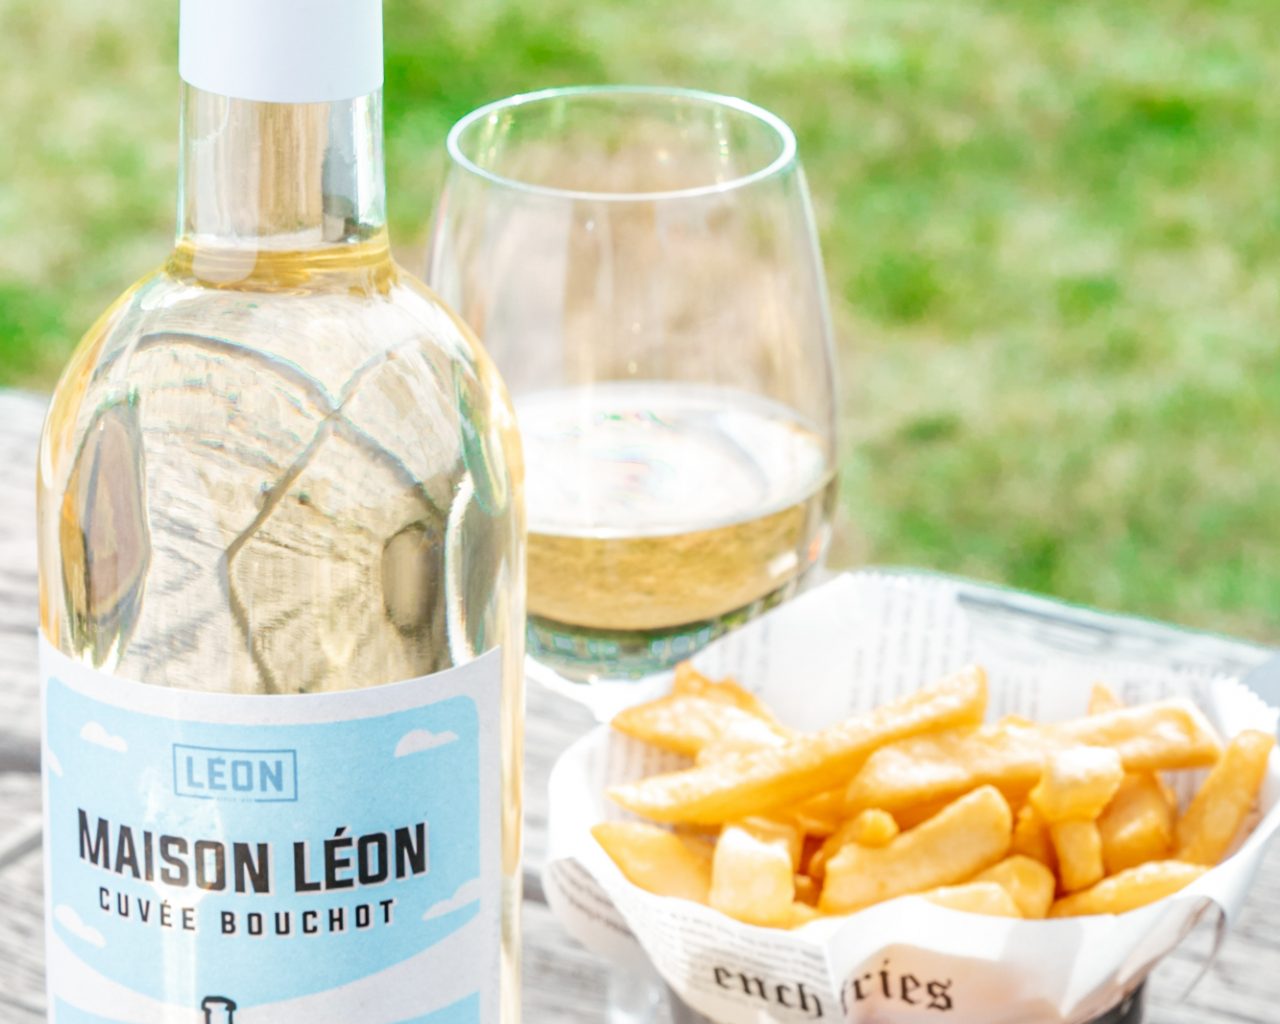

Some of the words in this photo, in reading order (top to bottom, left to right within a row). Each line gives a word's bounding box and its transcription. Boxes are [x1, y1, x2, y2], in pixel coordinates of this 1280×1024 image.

[185, 755, 285, 793] LÉON
[77, 807, 270, 893] MAISON
[293, 822, 428, 894] LÉON
[98, 886, 196, 931] CUVÉE
[221, 899, 395, 936] BOUCHOT
